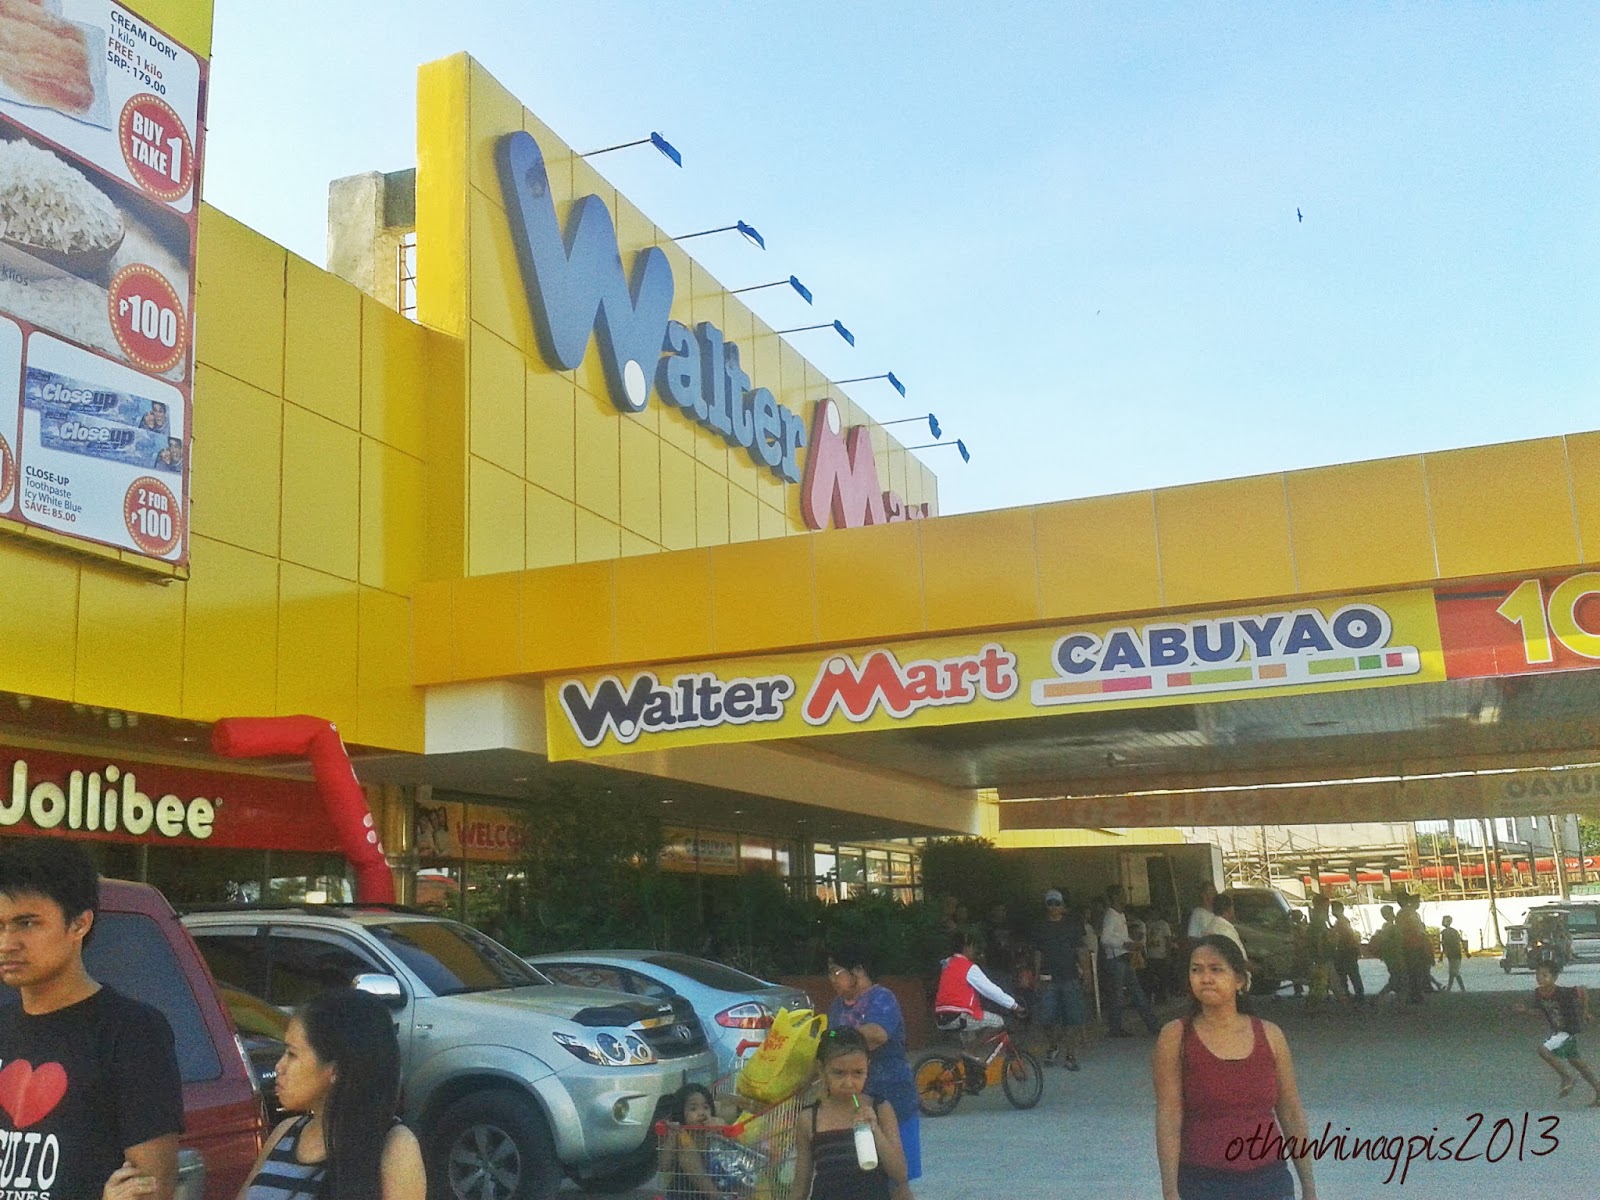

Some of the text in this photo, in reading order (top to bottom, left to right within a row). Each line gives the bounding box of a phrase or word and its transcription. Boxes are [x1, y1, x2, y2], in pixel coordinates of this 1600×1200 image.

[110, 24, 135, 48] 1 kilo
[111, 11, 177, 61] CREAM DORY
[107, 51, 166, 95] SRP: 179.00
[108, 37, 163, 80] FREE 1 kilo
[132, 110, 164, 147] BUY
[131, 135, 182, 184] TAKE 1
[497, 130, 806, 483] Walter
[42, 383, 118, 412] Closeup
[60, 421, 136, 450] Closeup
[25, 476, 72, 499] Toothpaste
[26, 465, 70, 486] CLOSE-UP
[25, 488, 82, 513] Icy White Blue
[25, 500, 51, 515] SAVE:
[138, 488, 168, 511] 2 FOR
[1058, 608, 1382, 674] CABUYAO
[562, 648, 1012, 742] Walter Mart
[0, 760, 215, 839] Jollibee
